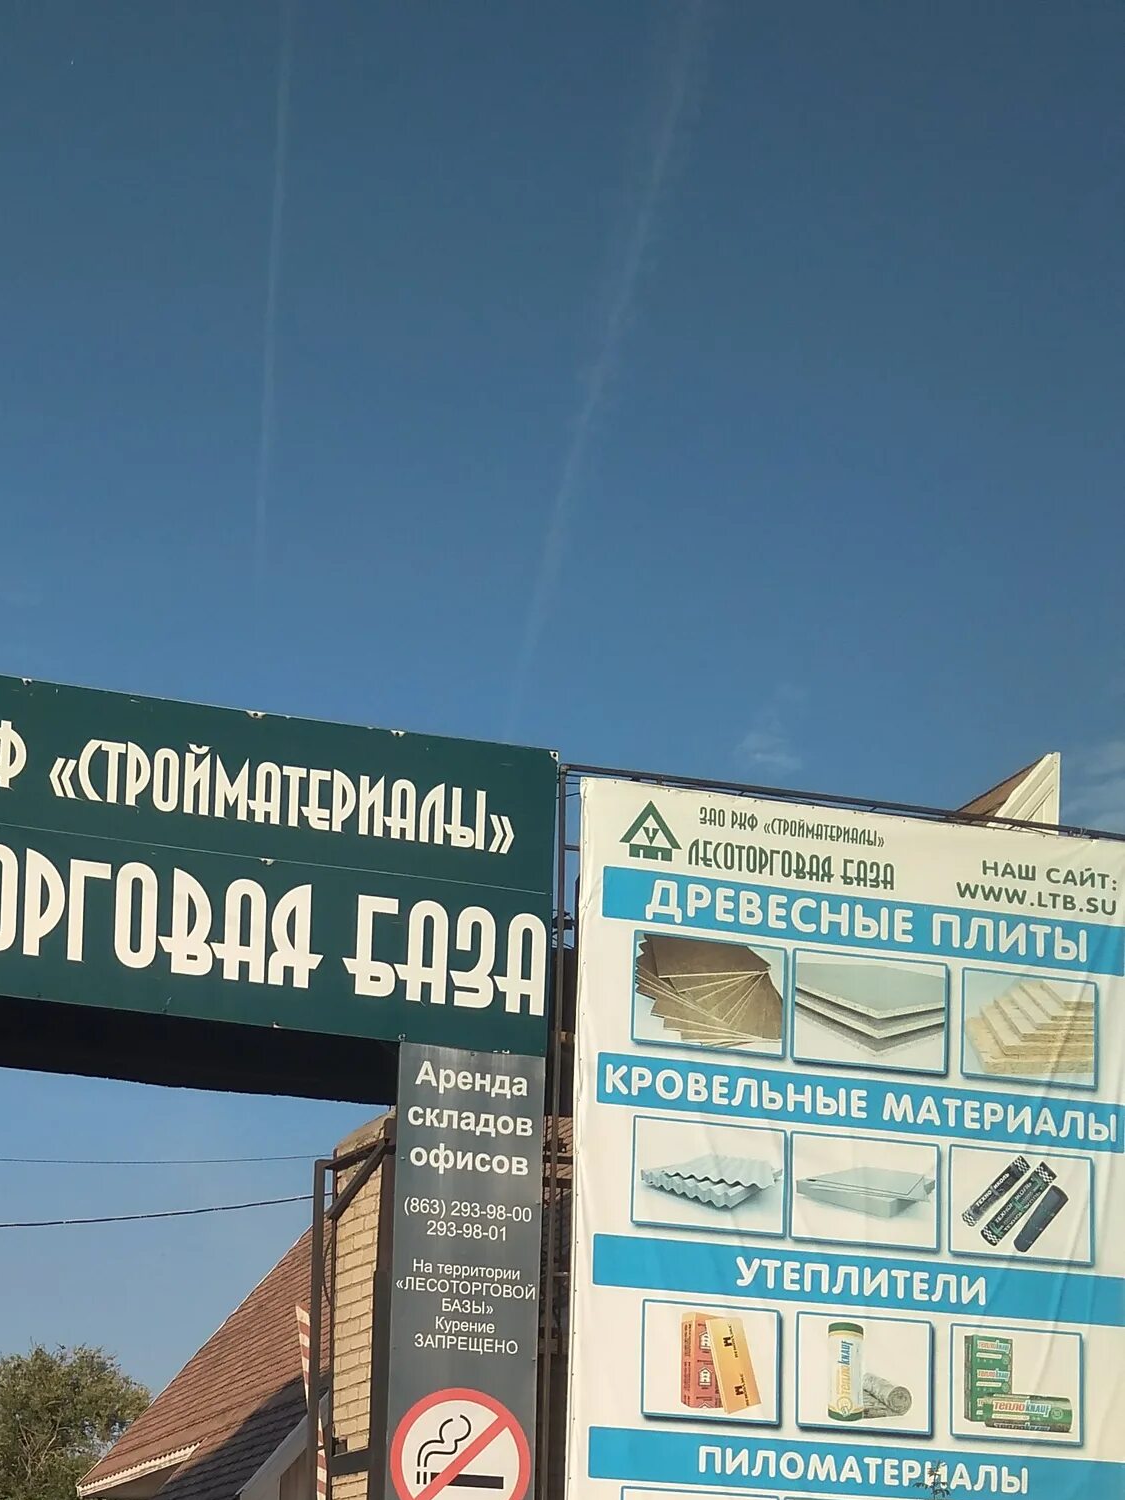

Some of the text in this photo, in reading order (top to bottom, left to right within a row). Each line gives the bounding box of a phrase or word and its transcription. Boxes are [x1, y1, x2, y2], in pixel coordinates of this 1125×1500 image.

[49, 738, 515, 855] «СТРОЙМАТЕРИАЛЫ»
[699, 806, 884, 848] ЗАО РКФ «СТРОЙМАТЕРИАЛЫ»
[687, 838, 895, 891] ЛЕСОТОРГОВАЯ БАЗА
[982, 860, 1117, 891] НАШ САЙТ:
[956, 881, 1116, 916] WWW.LTB.SU
[645, 879, 1088, 963] ДРЕВЕСНЫЕ ПЛИТЫ
[342, 893, 546, 1017] БАЗА
[415, 1060, 528, 1099] Аренда
[604, 1063, 1118, 1143] КРОВЕЛЬНЫЕ МАТЕРИАЛЫ
[407, 1105, 533, 1137] складов
[409, 1143, 529, 1176] офисов
[404, 1196, 532, 1223] (863) 293-98-00
[427, 1220, 507, 1241] 293-98-01
[413, 1258, 520, 1281] На территории
[735, 1256, 987, 1306] УТЕПЛИТЕЛИ
[395, 1276, 536, 1300] «ЛЕСОТОРГОВОЙ
[441, 1298, 494, 1315] БАЗЫ»
[435, 1316, 495, 1334] Курение
[414, 1333, 518, 1355] ЗАПРЕЩЕНО
[698, 1445, 1028, 1495] ПИЛОМАТЕРИАЛЫ
